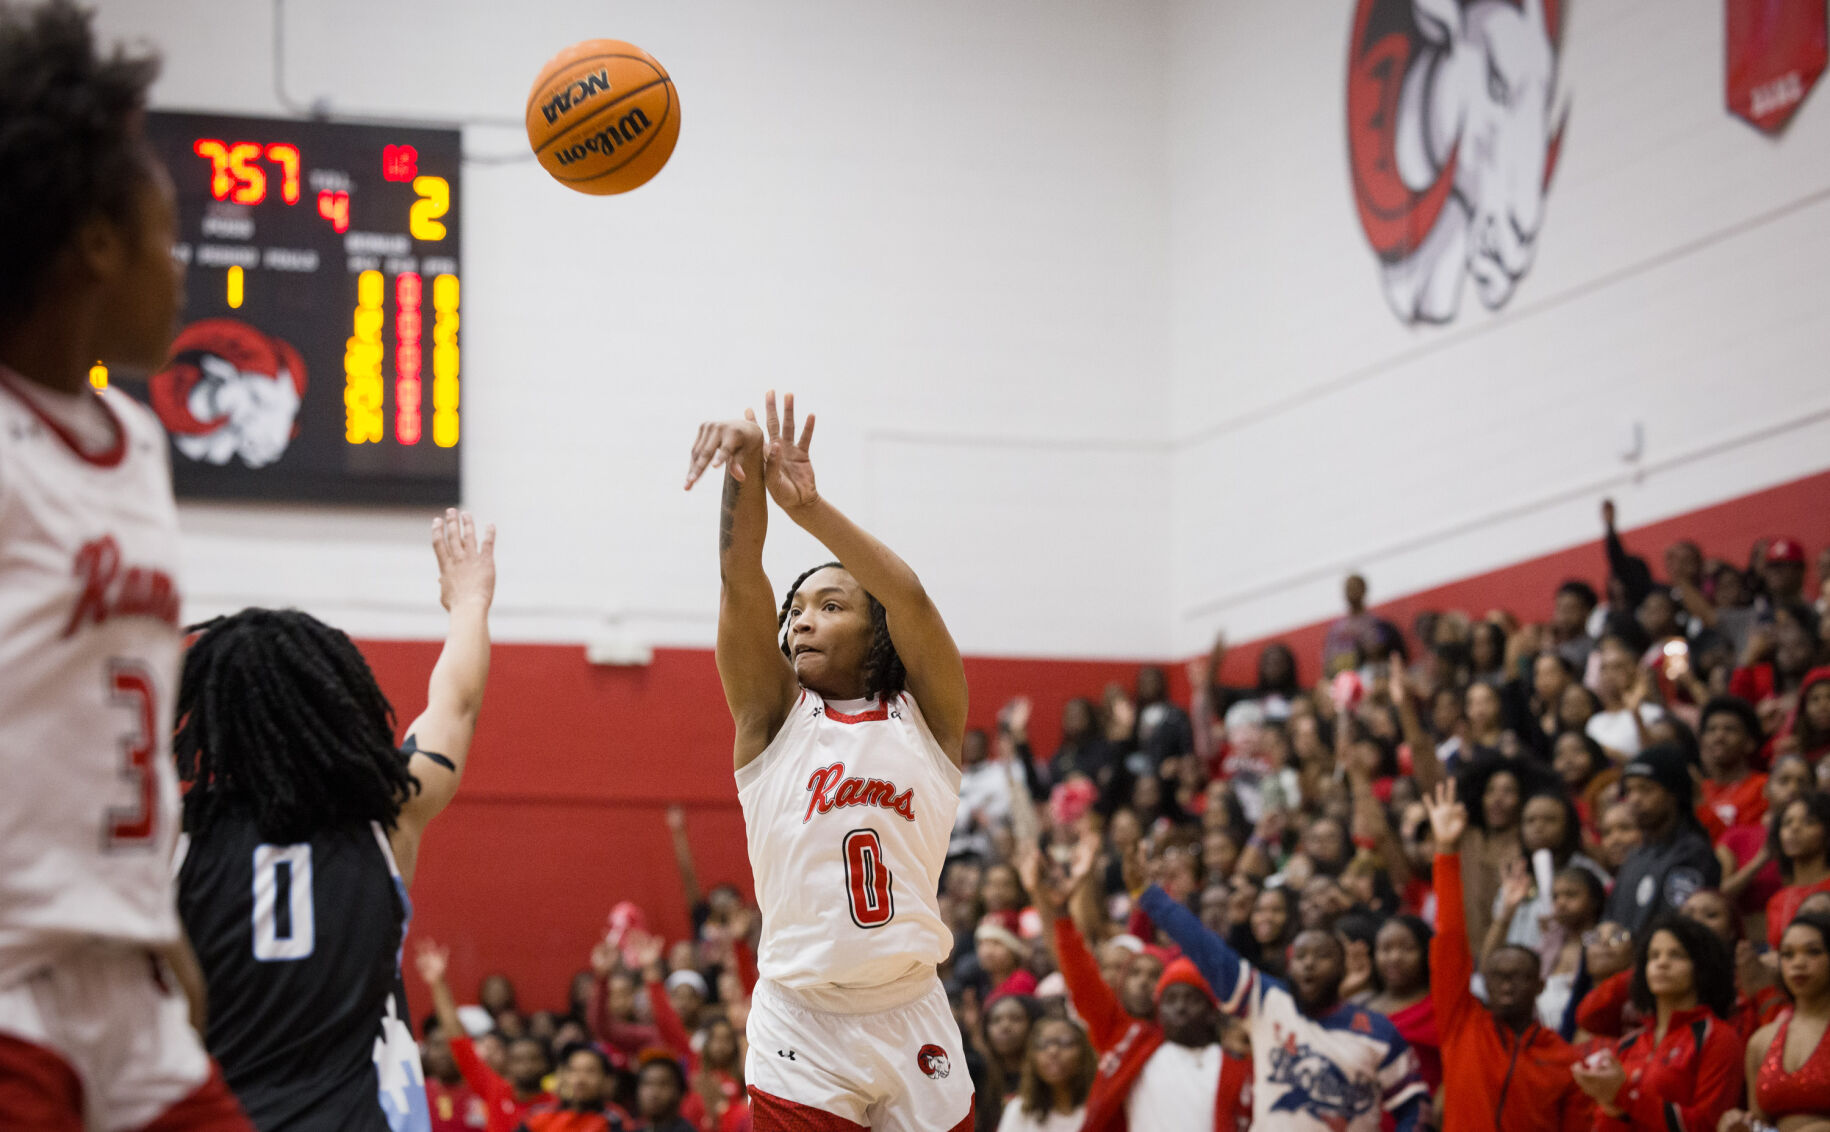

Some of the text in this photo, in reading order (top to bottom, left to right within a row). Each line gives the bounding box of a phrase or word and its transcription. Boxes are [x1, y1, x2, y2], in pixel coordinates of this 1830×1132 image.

[541, 69, 611, 125] NCAA
[554, 107, 652, 166] Wilson
[317, 189, 350, 234] 4
[409, 175, 450, 241] 2
[227, 265, 244, 308] 1
[103, 656, 160, 854] 3
[802, 762, 915, 824] Rams
[252, 842, 316, 962] 0
[842, 828, 895, 929] 0
